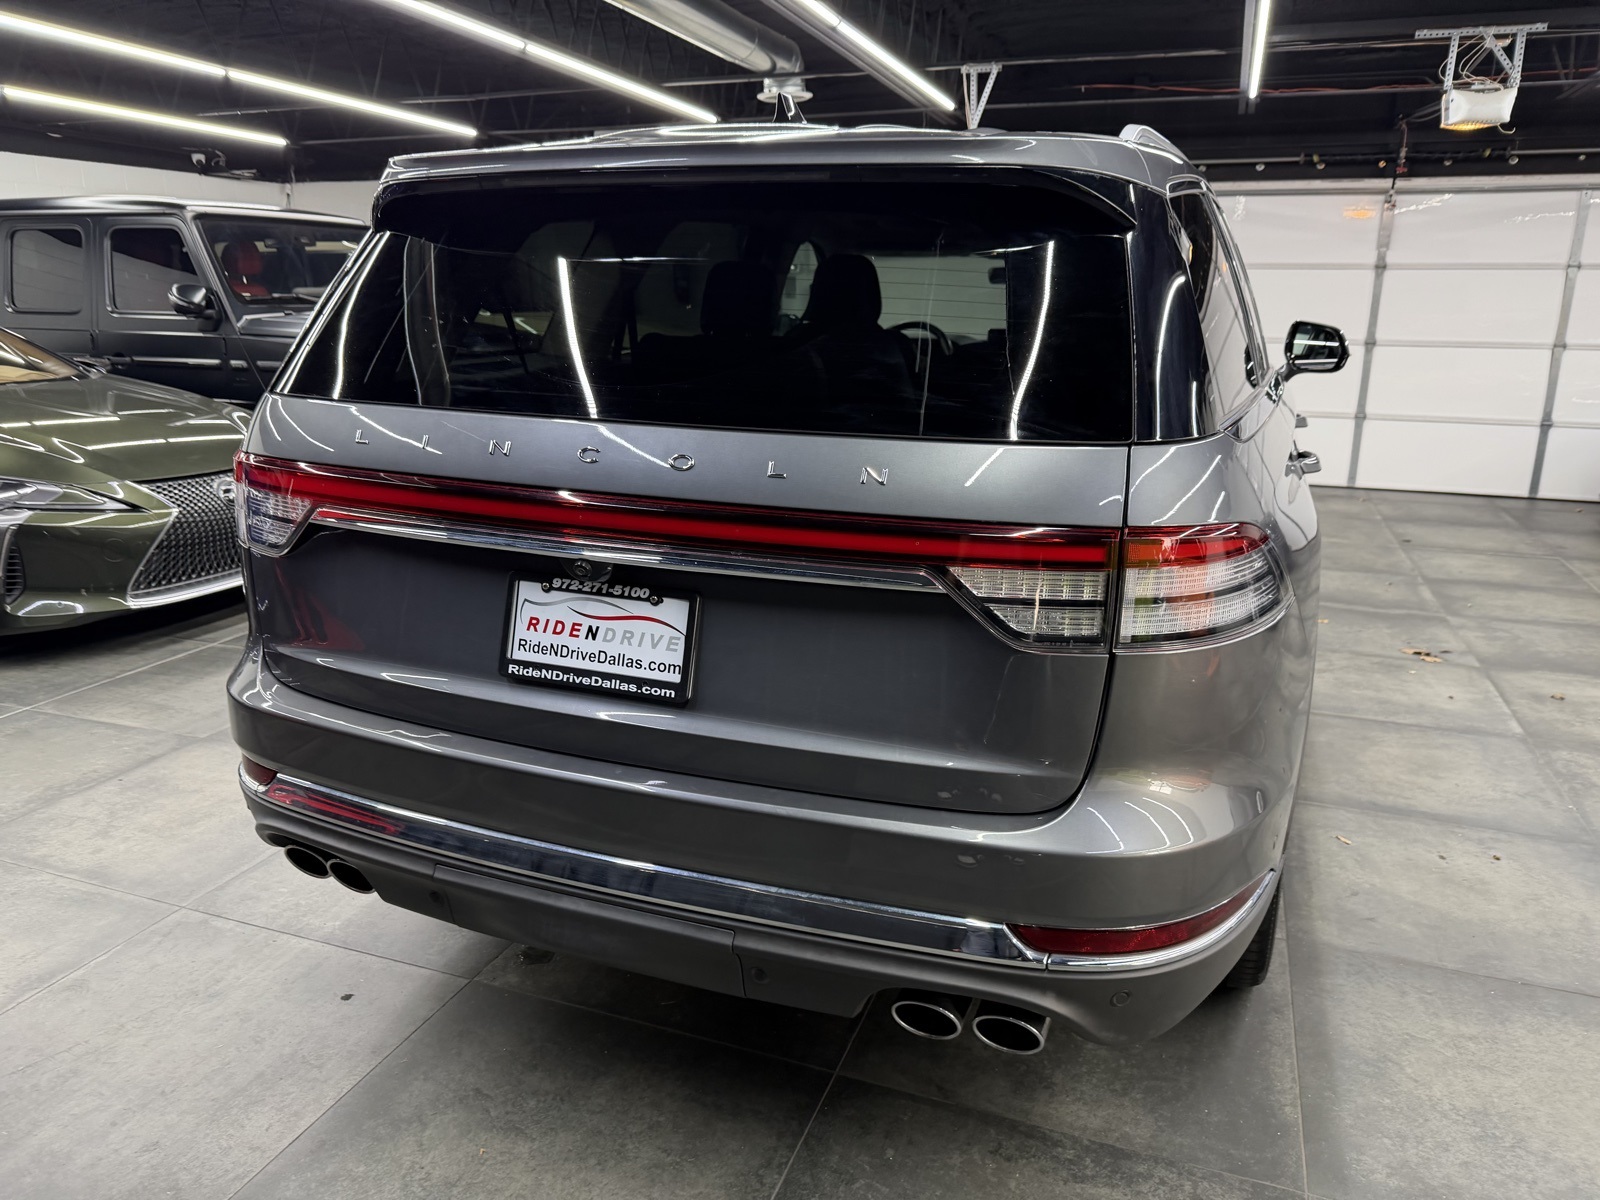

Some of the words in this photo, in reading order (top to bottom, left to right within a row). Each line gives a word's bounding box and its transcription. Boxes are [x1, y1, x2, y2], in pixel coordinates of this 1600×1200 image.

[355, 429, 889, 486] LINCOLN
[552, 577, 651, 599] 972-271-5100
[526, 616, 681, 653] RIDENDRIVE
[517, 638, 682, 675] RideNDriveDallas.com
[508, 664, 676, 698] RideNDriveDallas.com
